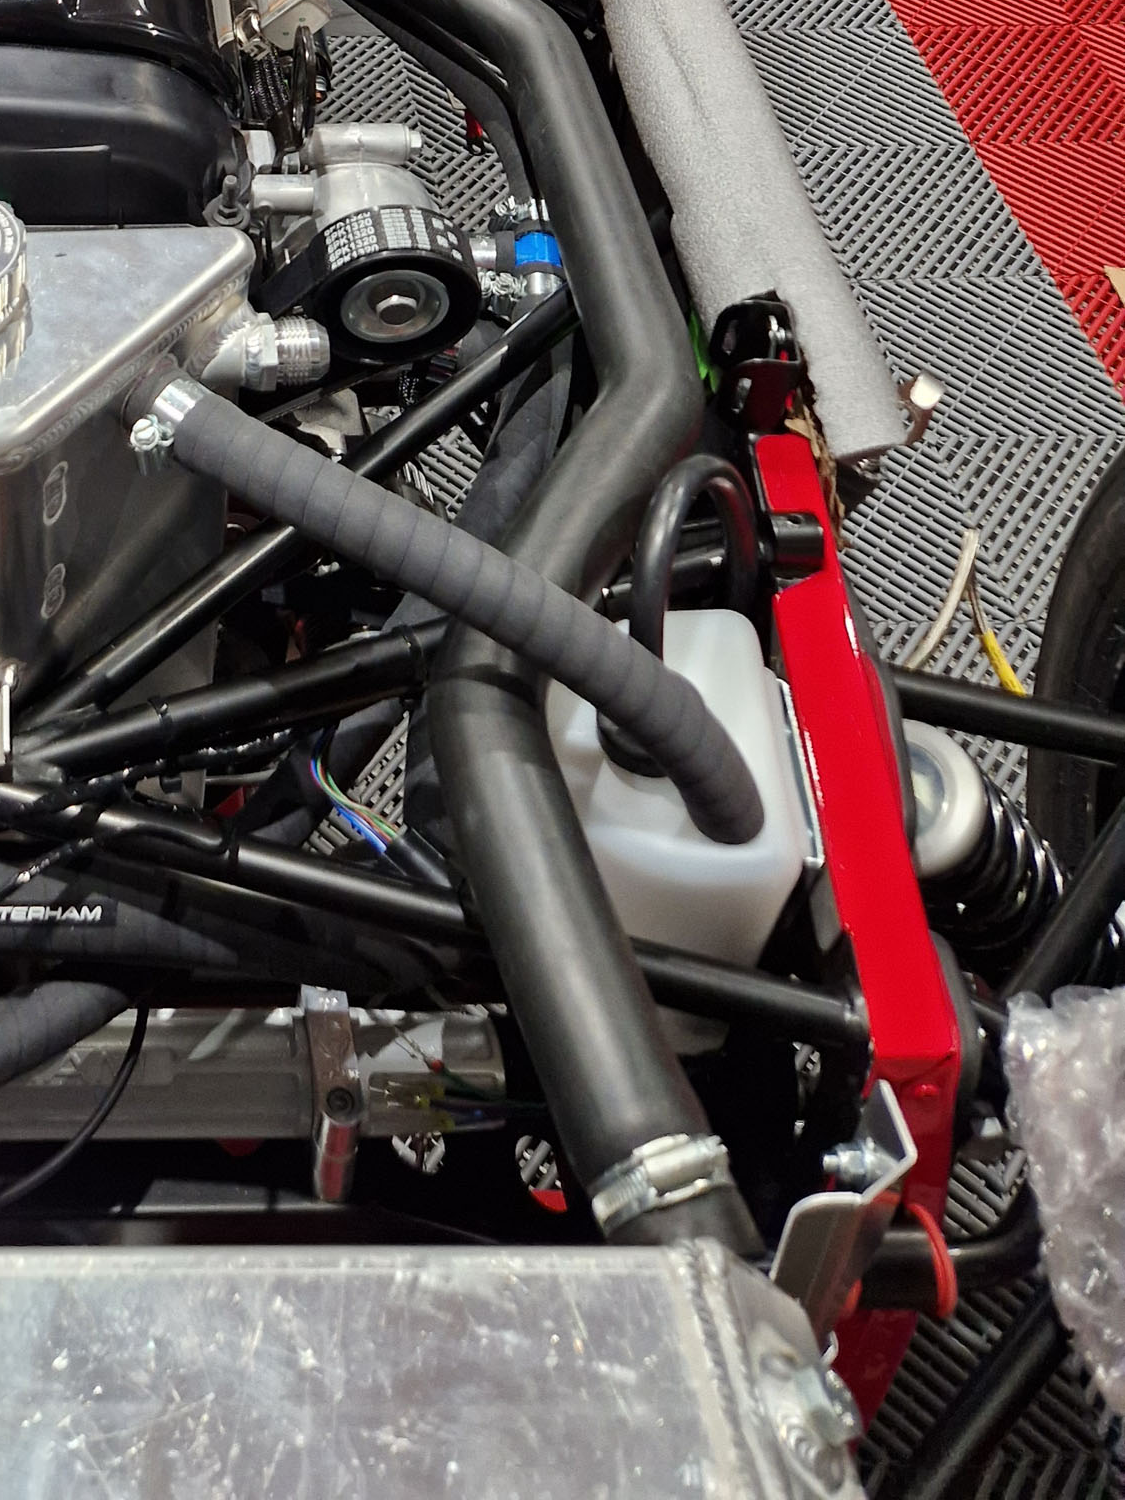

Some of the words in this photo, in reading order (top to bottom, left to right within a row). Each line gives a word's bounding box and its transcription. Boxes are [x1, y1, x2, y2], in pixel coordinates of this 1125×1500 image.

[325, 218, 373, 245] 6PK1320
[327, 226, 375, 253] 6PK1320
[329, 234, 378, 262] 6PK1320
